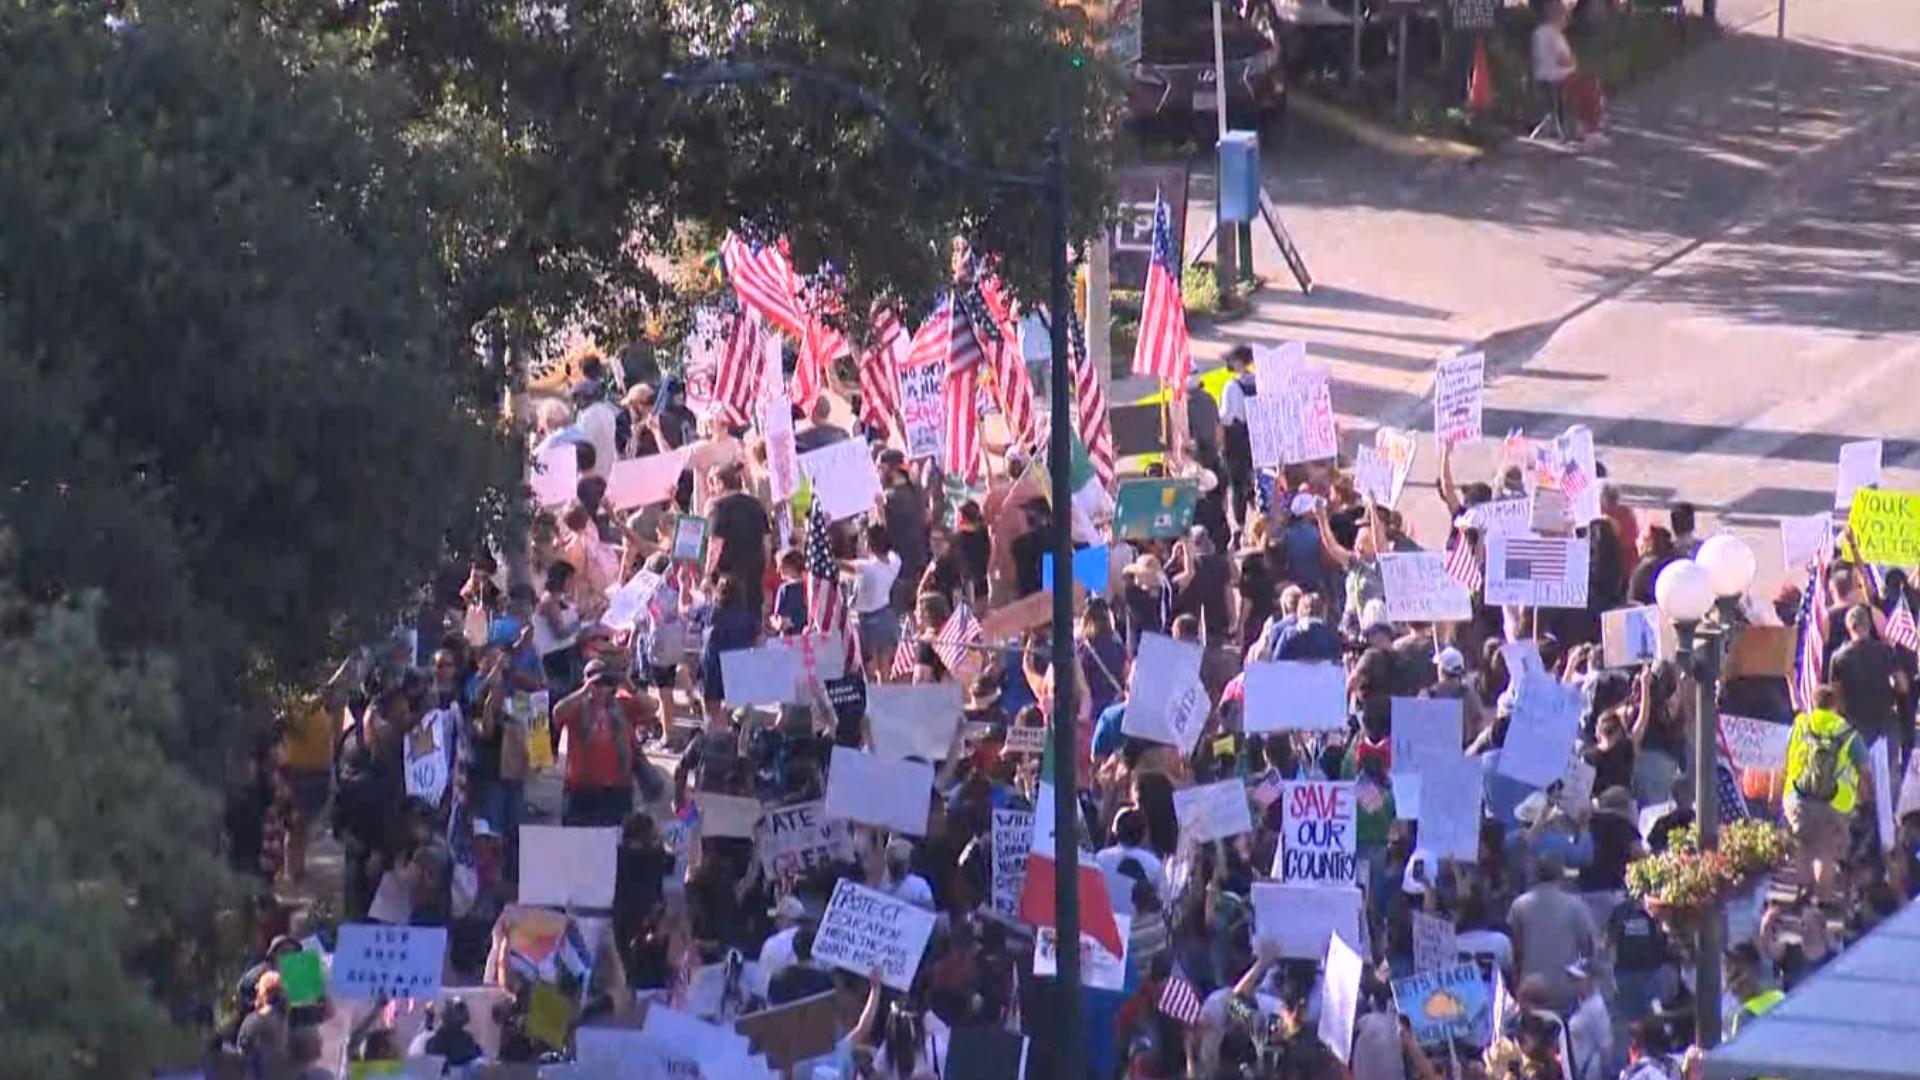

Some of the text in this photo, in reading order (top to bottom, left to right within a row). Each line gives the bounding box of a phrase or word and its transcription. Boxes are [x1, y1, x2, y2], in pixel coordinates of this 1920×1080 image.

[1860, 491, 1913, 519] YOUR
[1290, 784, 1351, 819] SAVE
[1297, 819, 1346, 851] OUR
[1285, 848, 1357, 881] COUNTRY
[830, 880, 903, 920] PROTECT
